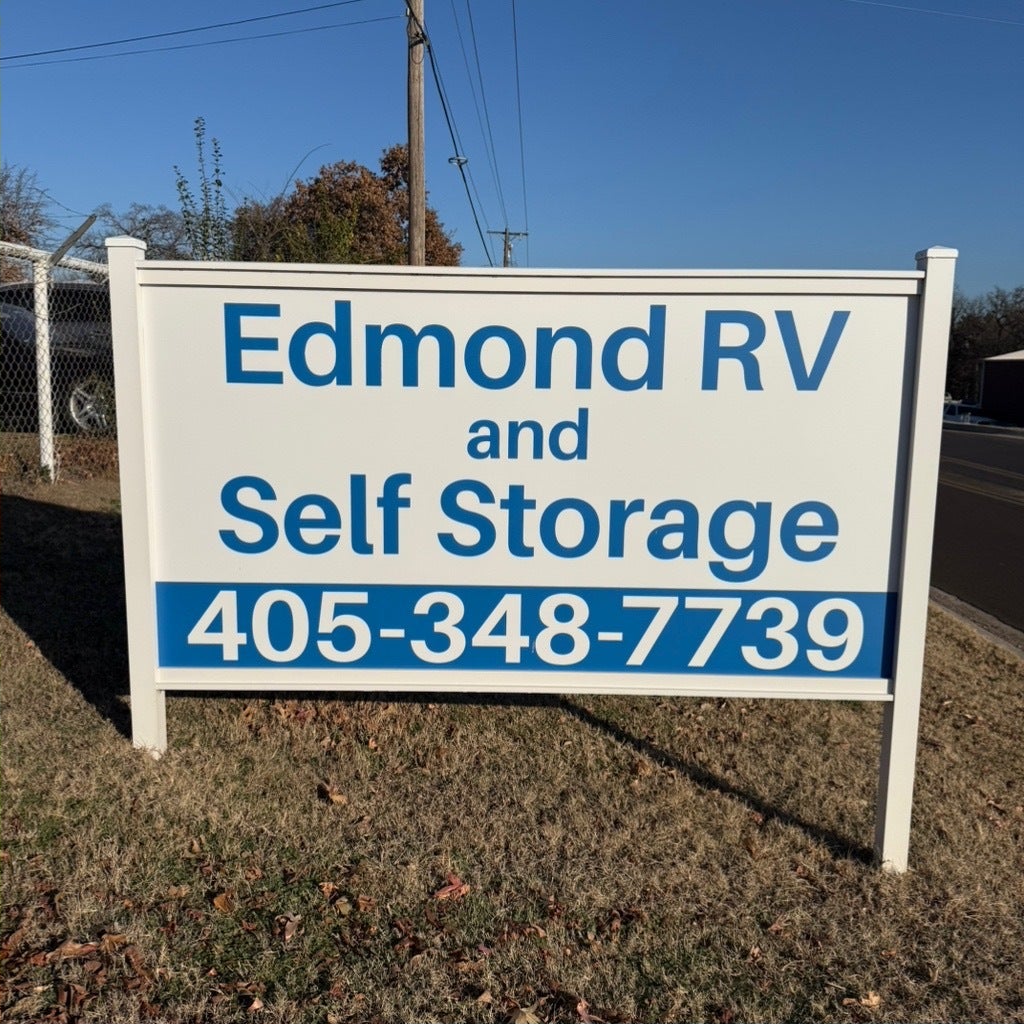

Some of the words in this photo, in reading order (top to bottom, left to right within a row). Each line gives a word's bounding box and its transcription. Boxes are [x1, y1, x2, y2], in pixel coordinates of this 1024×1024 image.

[224, 300, 666, 391] Edmond
[701, 310, 851, 391] RV
[467, 408, 588, 460] and
[219, 473, 411, 555] Self
[437, 479, 839, 582] Storage
[187, 590, 864, 671] 405-348-7739
